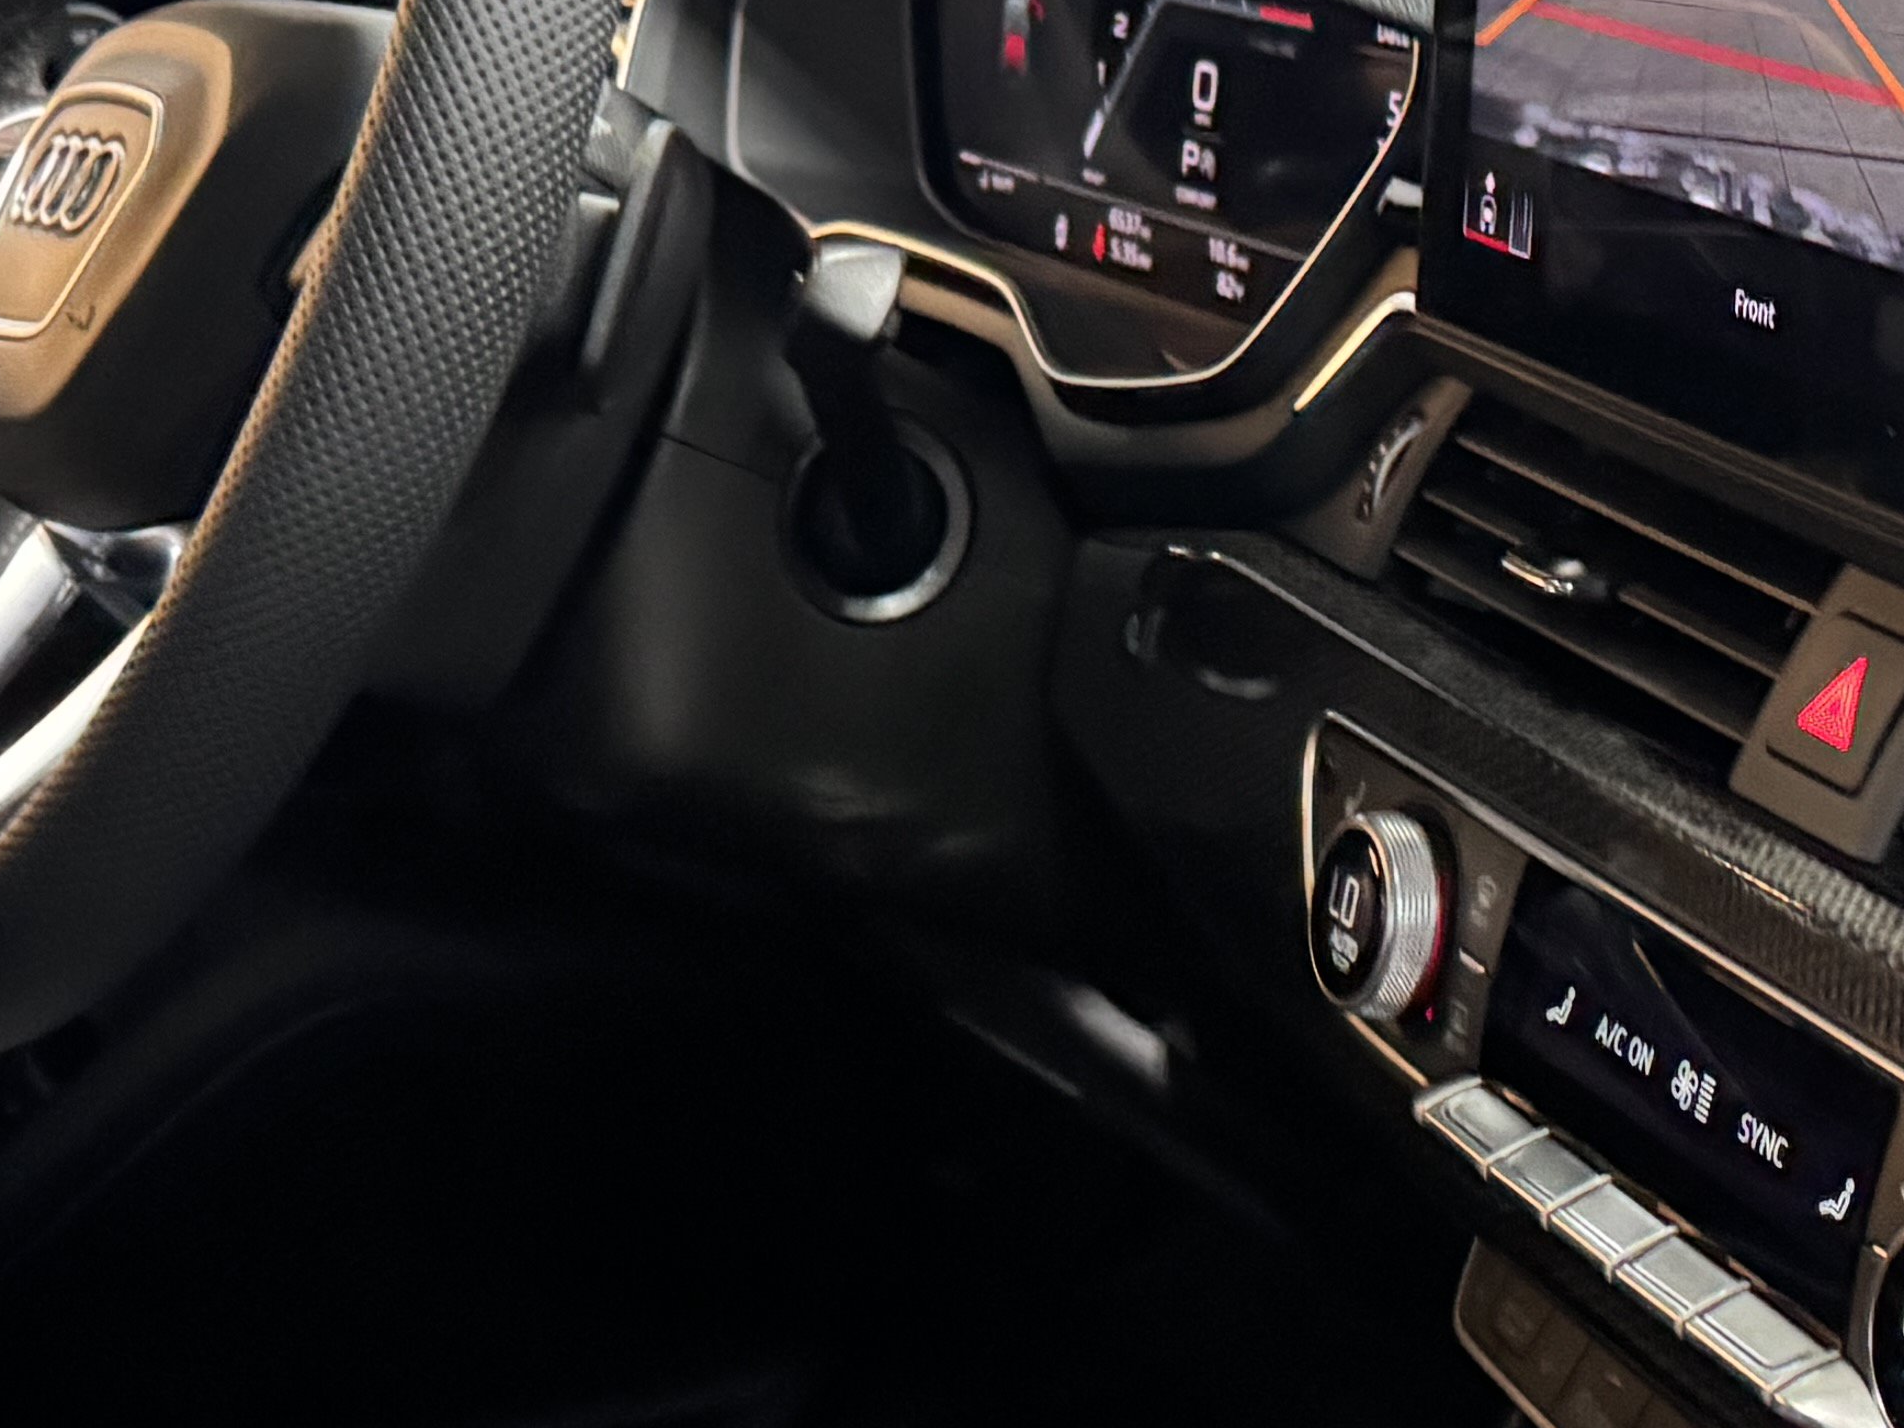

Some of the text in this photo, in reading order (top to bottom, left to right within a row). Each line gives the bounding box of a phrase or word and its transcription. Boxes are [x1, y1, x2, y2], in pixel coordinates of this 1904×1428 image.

[1735, 288, 1776, 330] Front
[1594, 1012, 1656, 1076] A/C ON
[1737, 1111, 1789, 1169] SYNC
